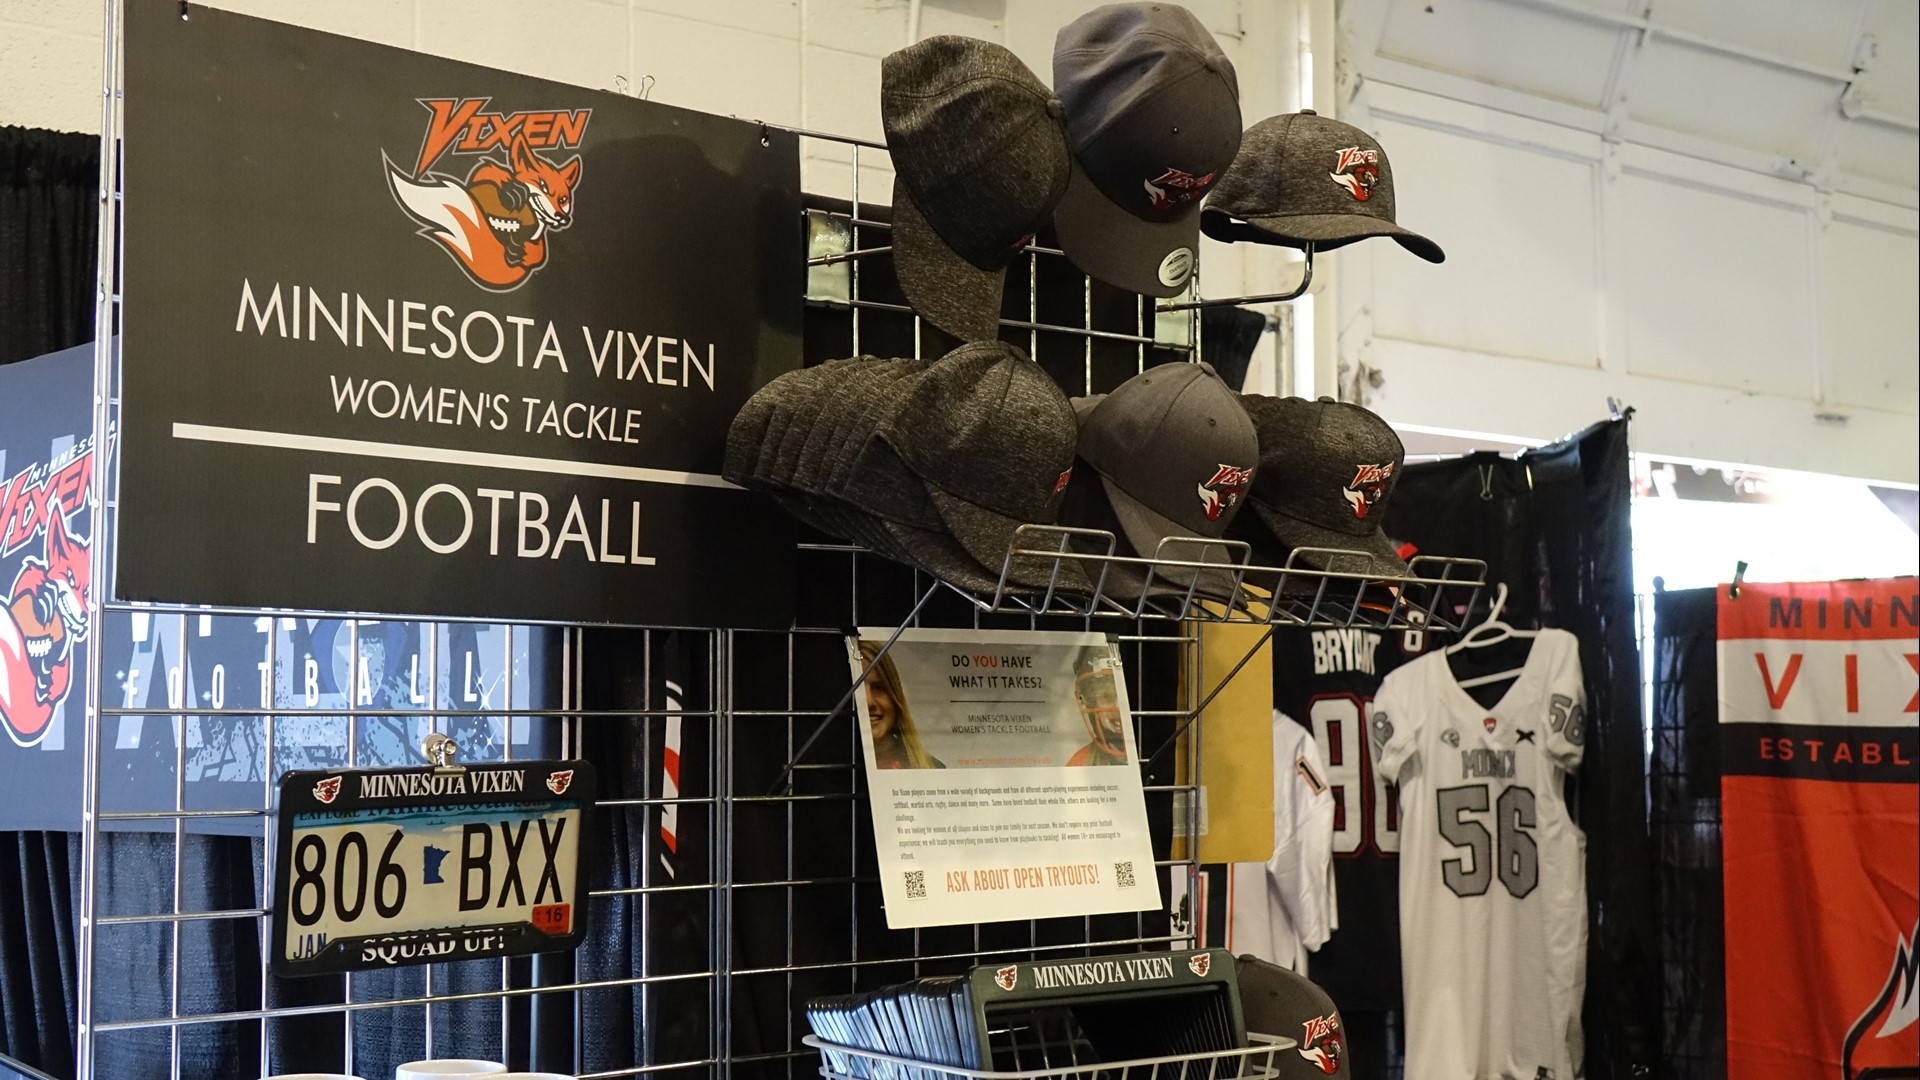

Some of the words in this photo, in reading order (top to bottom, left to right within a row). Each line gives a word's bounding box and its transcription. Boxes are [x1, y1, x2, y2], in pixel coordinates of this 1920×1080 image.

[416, 97, 592, 175] VIXEN
[236, 279, 568, 373] MINNESOTA
[582, 325, 715, 391] VIXEN
[330, 374, 509, 431] WOMEN'S
[521, 398, 642, 444] TACKLE
[306, 473, 657, 566] FOOTBALL
[951, 654, 970, 668] DO
[973, 654, 998, 669] YOU
[1001, 655, 1033, 669] HAVE
[949, 675, 984, 689] WHAT
[987, 676, 998, 689] IT
[1001, 676, 1042, 689] TAKES?
[967, 714, 1010, 723] MINNESOTA
[987, 725, 1015, 734] TACKLE
[1015, 725, 1051, 735] FOOTBALL
[1760, 737, 1910, 766] ESTABL
[359, 773, 467, 799] MINNESOTA
[471, 769, 525, 793] VIXEN
[1295, 755, 1327, 796] 1
[1436, 783, 1539, 899] 56
[291, 828, 407, 926] 806
[459, 819, 567, 911] BXX
[946, 870, 971, 893] ASK
[973, 868, 1010, 892] ABOUT
[1013, 866, 1044, 889] OPEN
[1045, 863, 1101, 887] TRYOUTS!
[545, 906, 563, 923] 16
[293, 932, 327, 960] JAN
[361, 932, 457, 964] SQUAD
[462, 927, 505, 952] UP!
[1032, 961, 1125, 989] MINNESOTA
[1125, 957, 1174, 980] VIXEN
